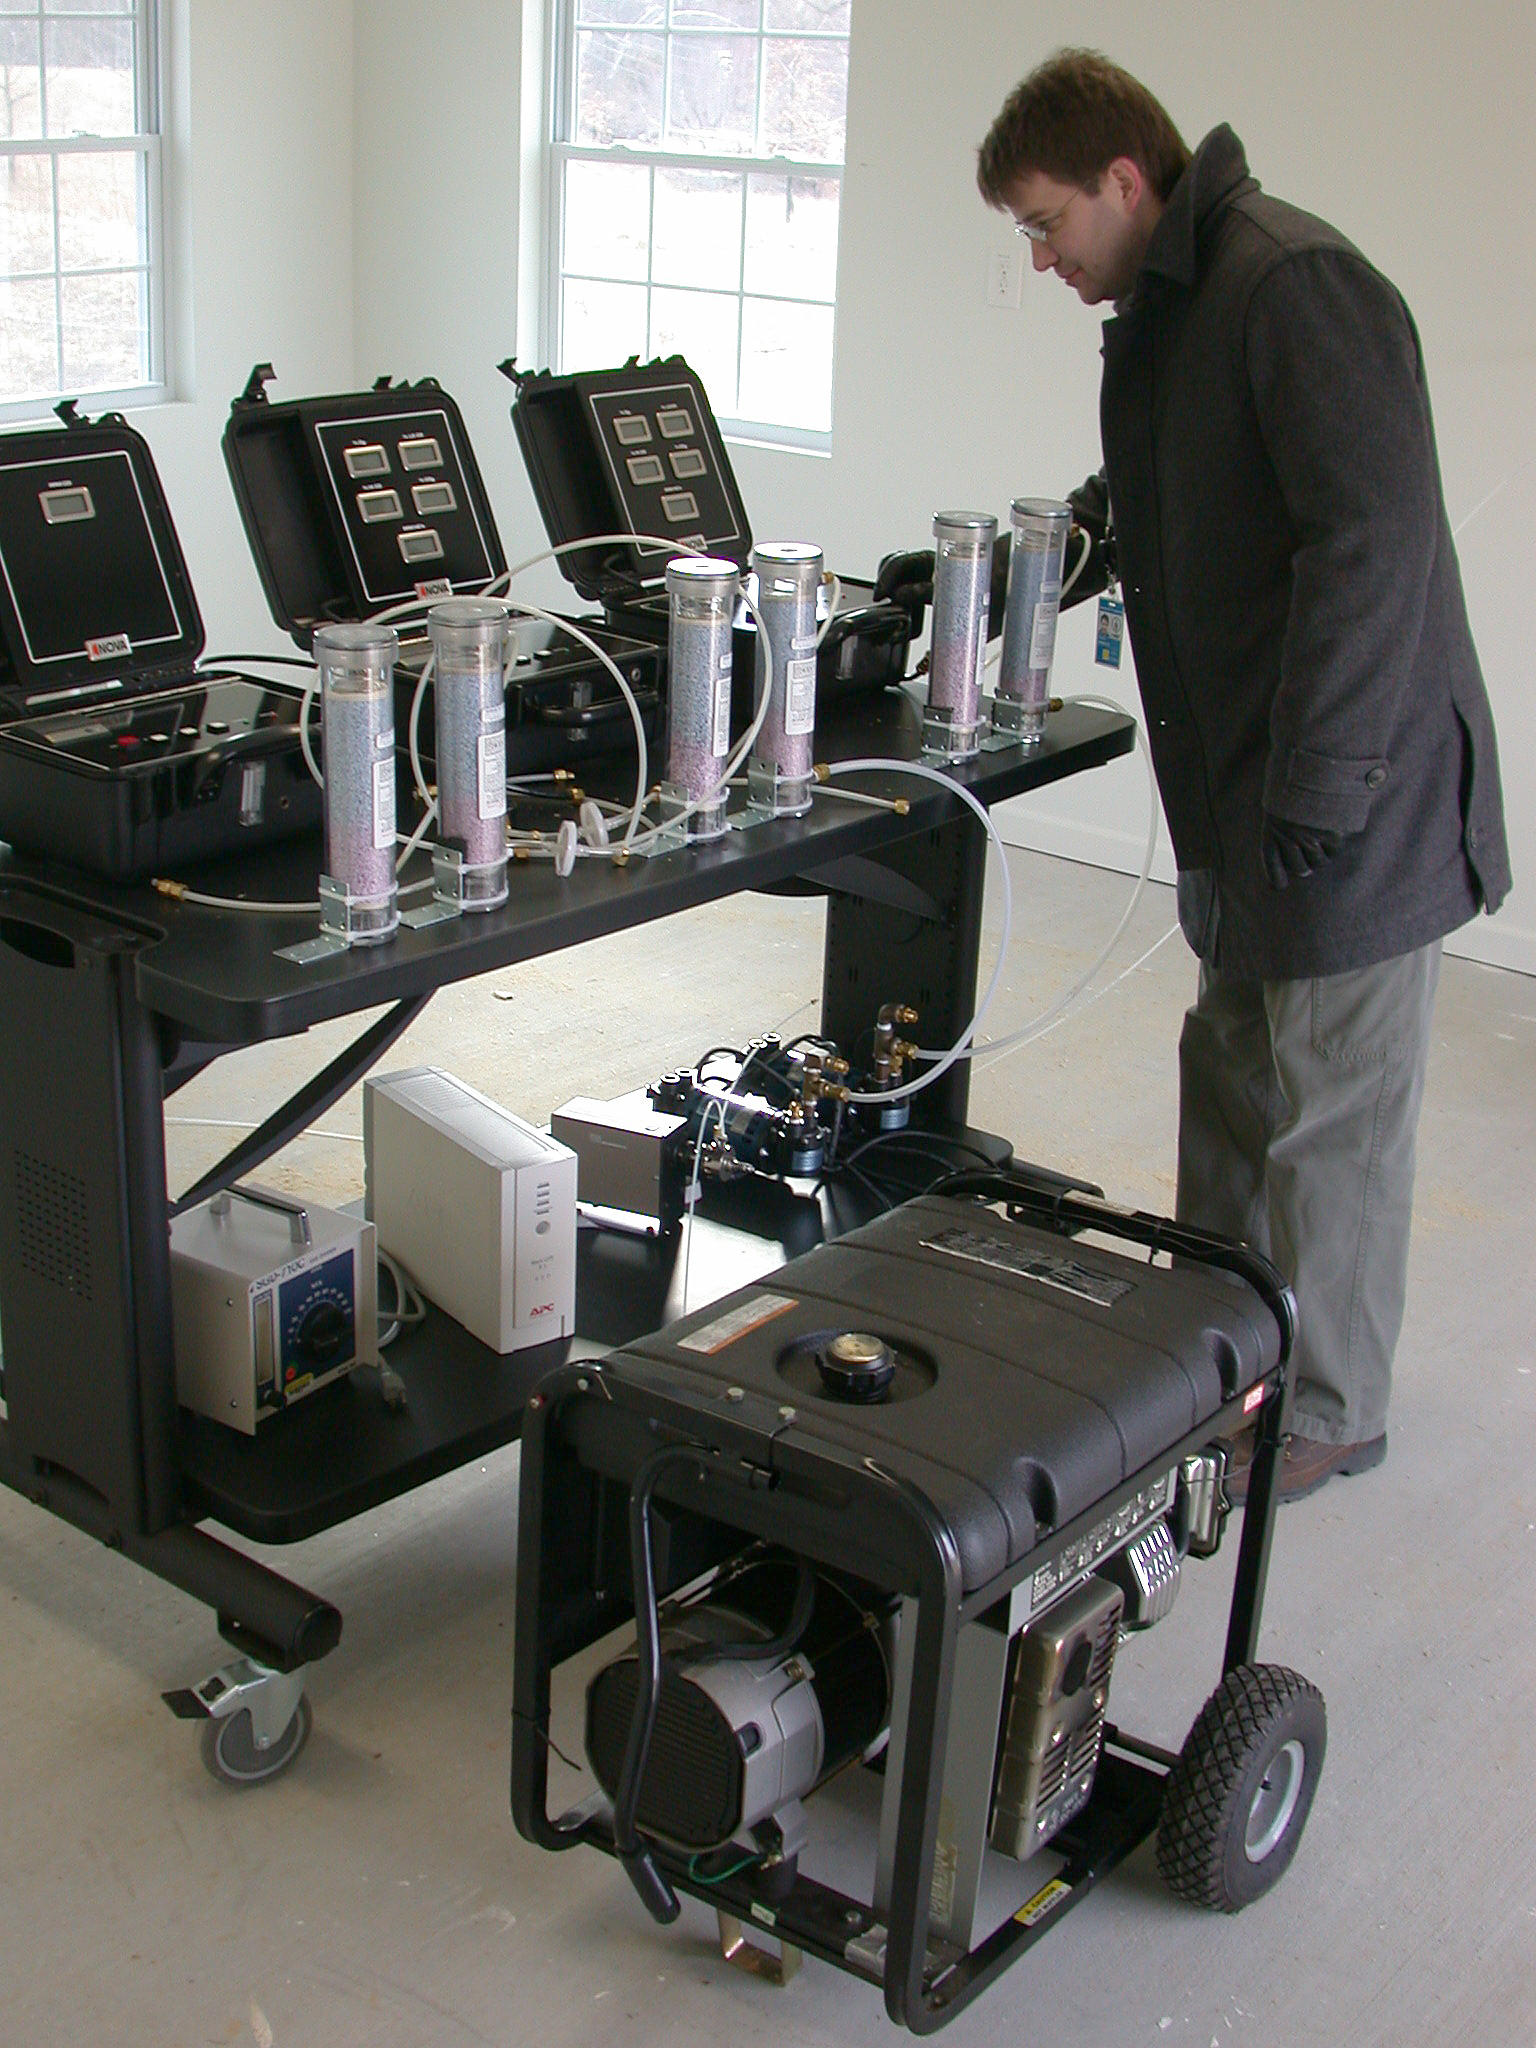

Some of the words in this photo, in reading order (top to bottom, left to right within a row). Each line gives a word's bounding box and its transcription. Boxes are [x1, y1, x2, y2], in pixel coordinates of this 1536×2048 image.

[425, 584, 450, 596] NOVA
[97, 639, 128, 654] NOVA
[530, 1302, 555, 1316] APC
